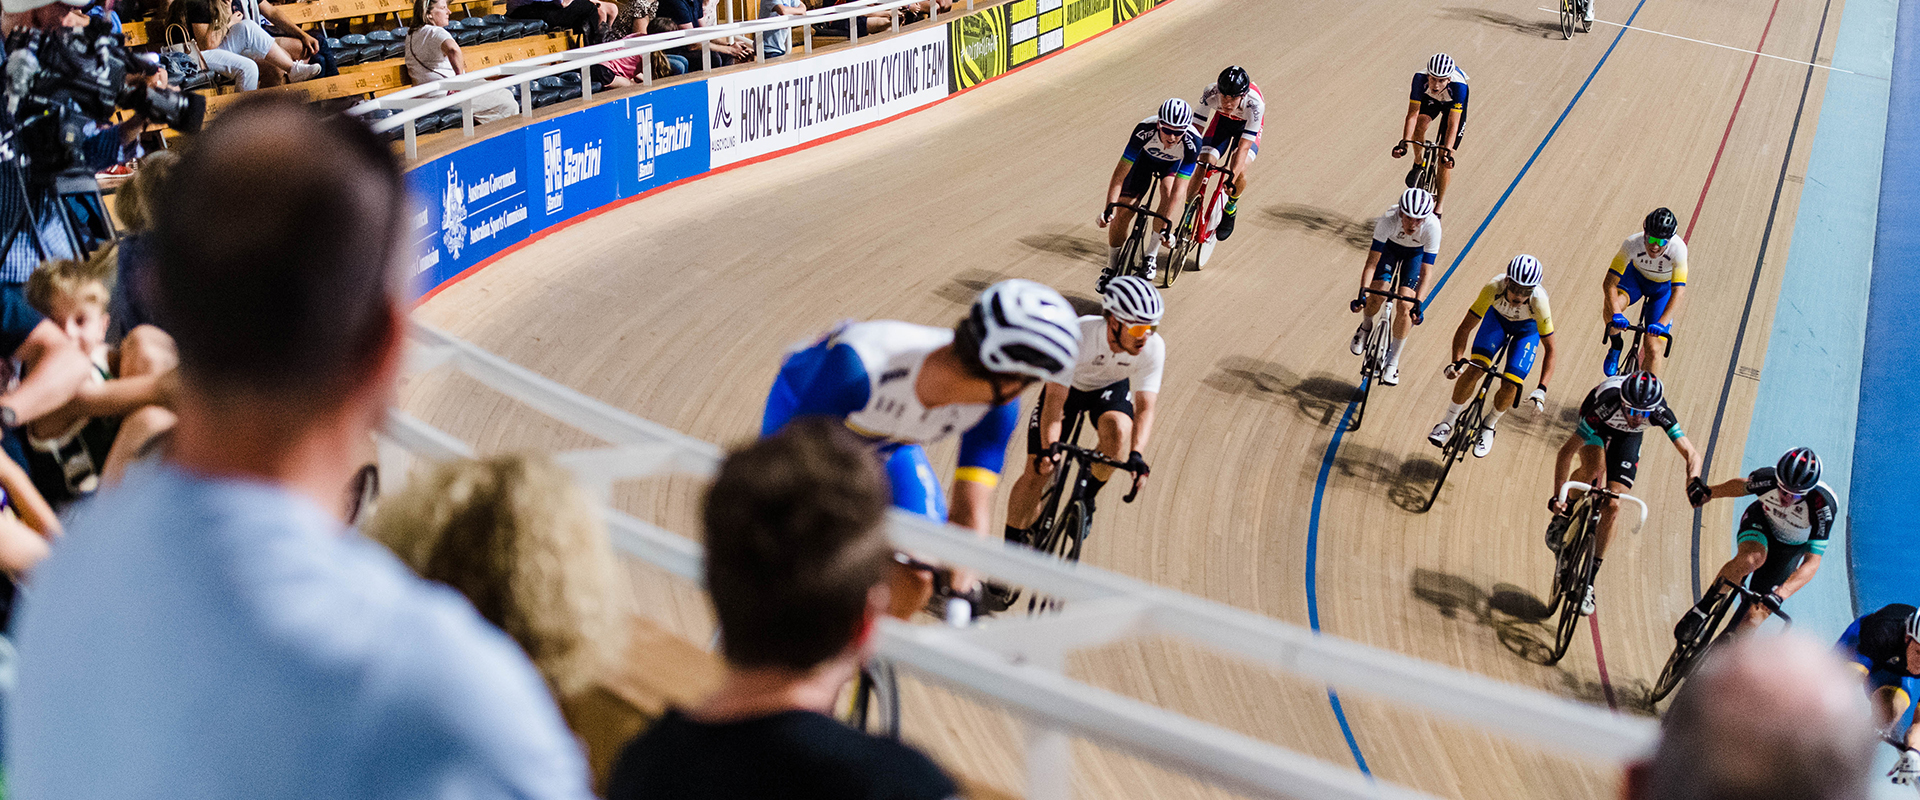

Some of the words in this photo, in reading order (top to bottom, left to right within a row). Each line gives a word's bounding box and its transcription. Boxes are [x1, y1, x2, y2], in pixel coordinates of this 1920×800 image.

[741, 83, 772, 144] HOME
[776, 80, 790, 135] OF
[794, 74, 814, 130] THE
[815, 58, 877, 124] AUSTRALIAN
[880, 46, 918, 105] CYCLING
[922, 39, 945, 91] TEAM
[655, 113, 694, 157] Santini
[468, 177, 490, 204] Australian
[489, 166, 517, 194] Government
[563, 138, 602, 188] Santini
[470, 220, 491, 245] Australian
